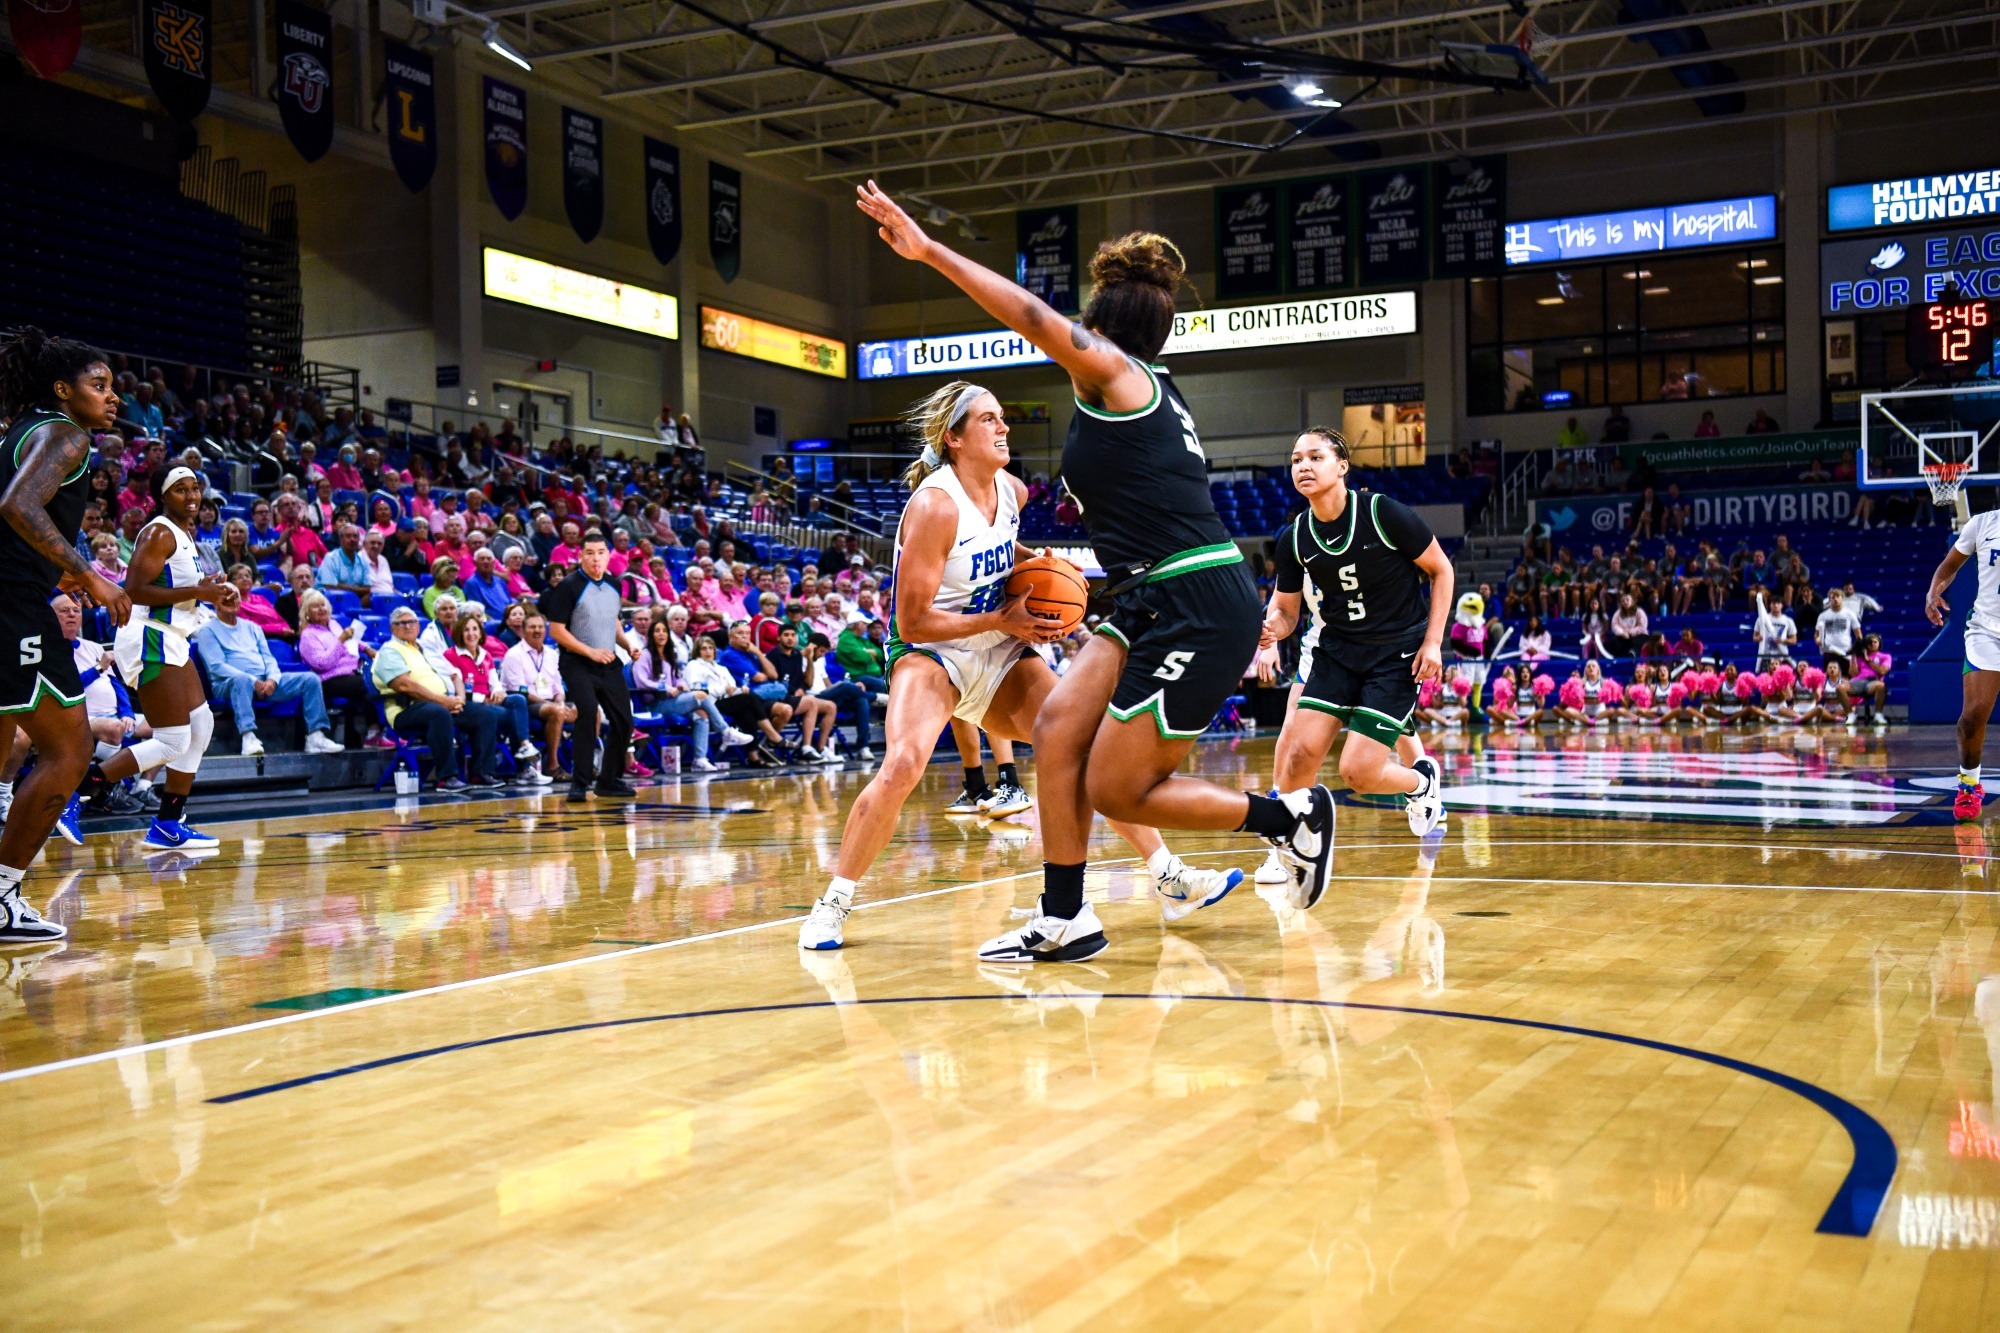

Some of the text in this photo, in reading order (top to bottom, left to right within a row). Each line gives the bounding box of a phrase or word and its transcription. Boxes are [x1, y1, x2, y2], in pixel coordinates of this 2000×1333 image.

[283, 21, 325, 49] LIBERTY
[397, 89, 426, 144] L
[1874, 190, 2000, 225] FOUNDAT
[1547, 199, 1758, 250] This is my hospital.
[1830, 277, 1910, 312] FOR
[1228, 297, 1388, 332] CONTRACTORS
[1928, 303, 1987, 330] 5:46
[715, 316, 739, 349] 60
[1942, 329, 1971, 362] 12
[914, 343, 963, 366] BUD
[969, 538, 1014, 582] FGCU
[1338, 563, 1360, 592] S
[20, 634, 42, 666] S
[1151, 650, 1196, 682] S
